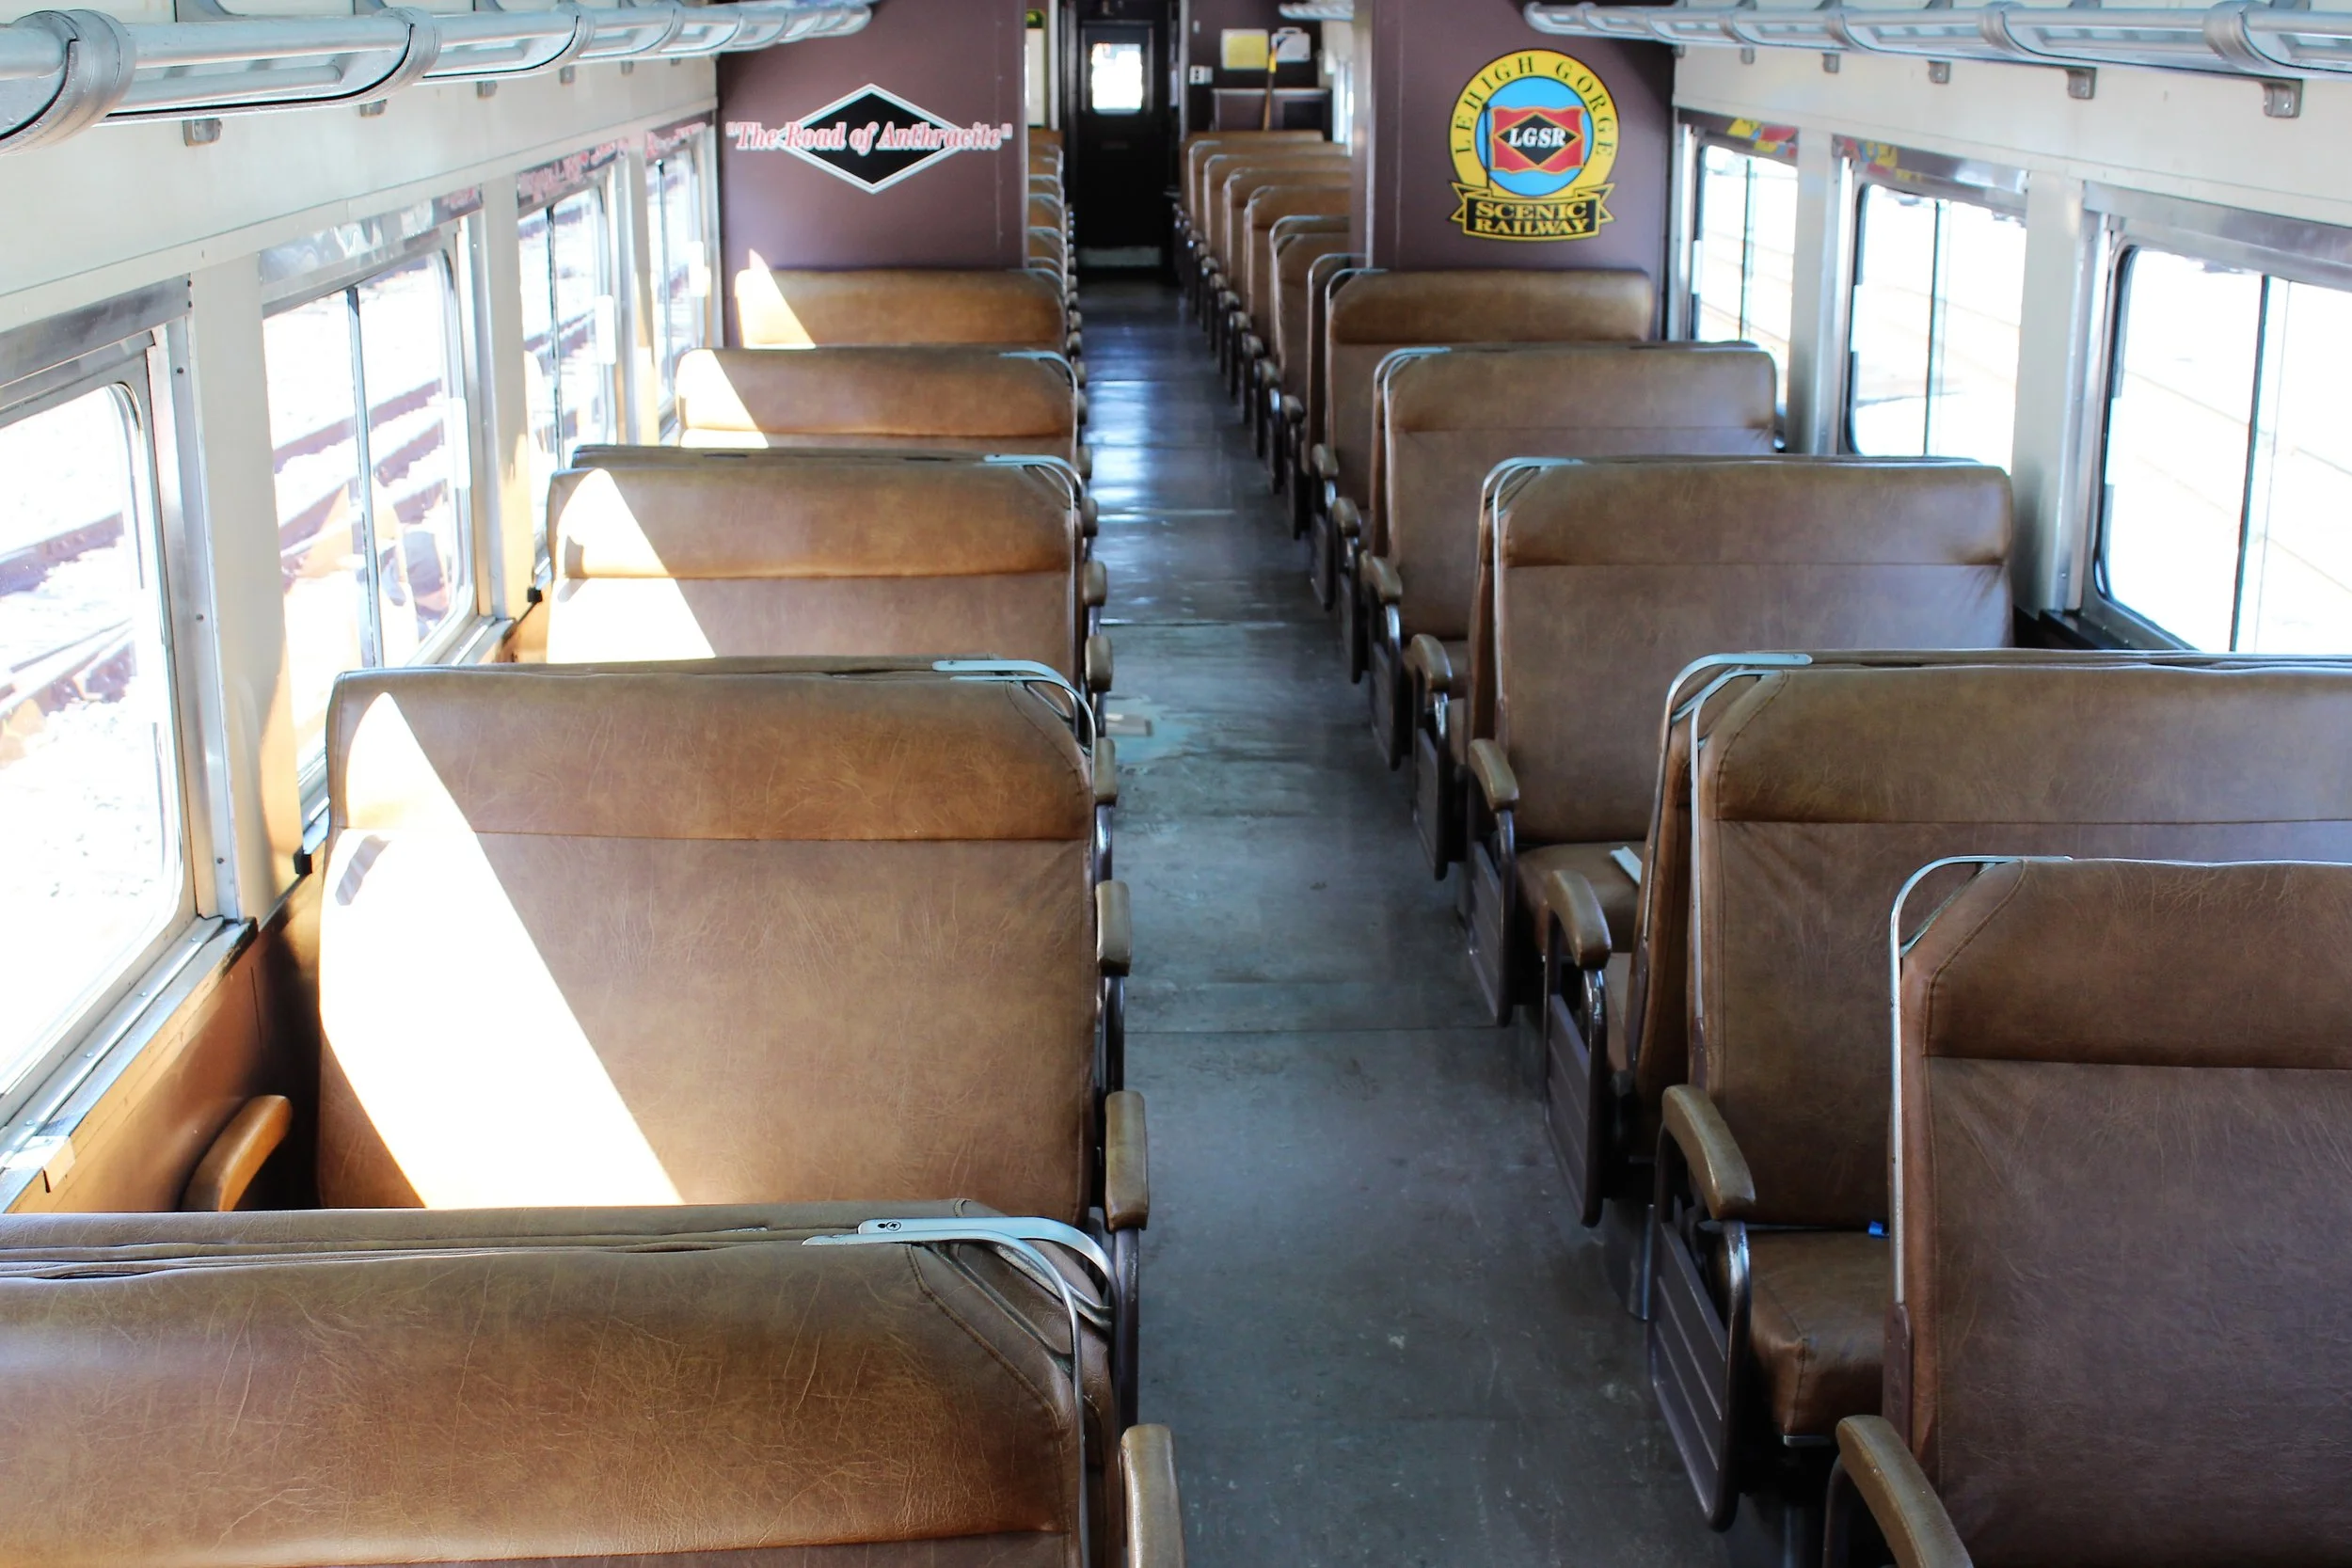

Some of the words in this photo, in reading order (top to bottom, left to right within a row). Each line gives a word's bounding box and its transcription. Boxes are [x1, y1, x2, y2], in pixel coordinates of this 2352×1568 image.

[1455, 55, 1535, 153] LEHIGH
[1555, 60, 1613, 156] GORGE
[783, 122, 848, 150] Road
[849, 121, 880, 156] of
[1508, 127, 1566, 148] LGSR
[1475, 201, 1587, 219] SCENIC
[1474, 218, 1589, 235] RAILWAY
